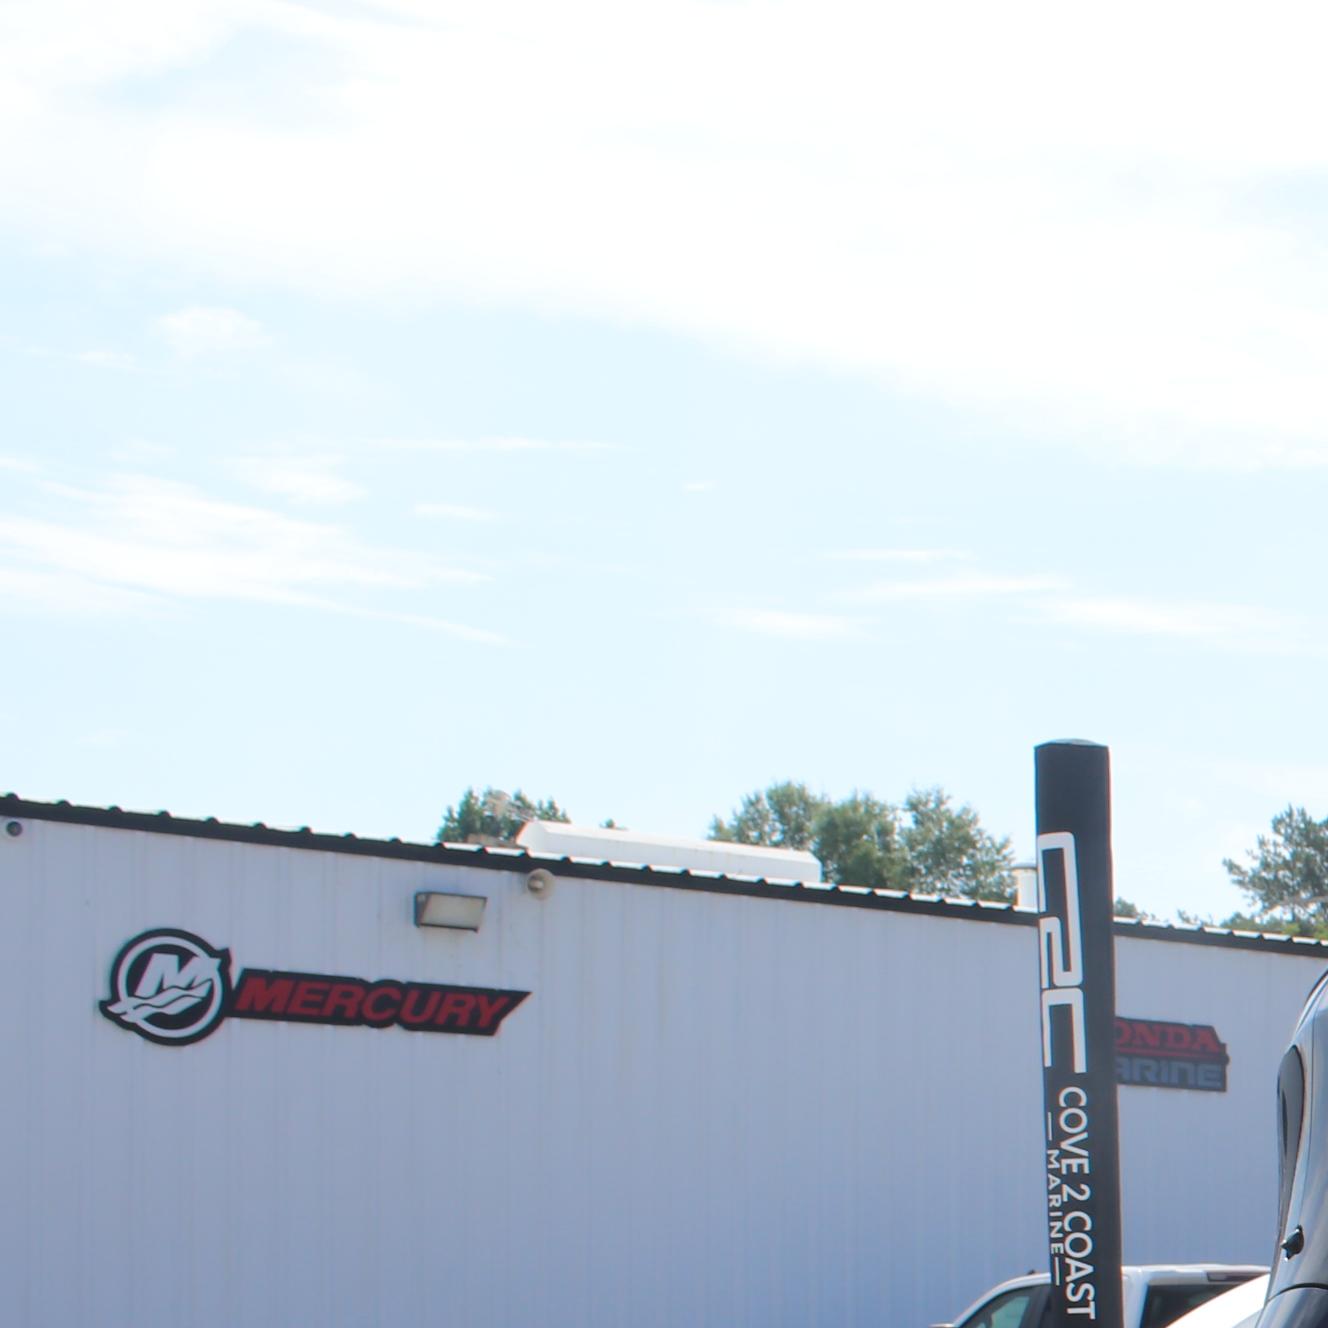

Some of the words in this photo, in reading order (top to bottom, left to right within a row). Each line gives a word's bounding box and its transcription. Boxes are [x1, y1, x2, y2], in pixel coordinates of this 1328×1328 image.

[1036, 831, 1087, 1073] C2C
[234, 976, 509, 1028] MERCURY
[1114, 1020, 1222, 1052] ONDA
[1114, 1056, 1223, 1089] ARINE
[1058, 1086, 1090, 1175] COVE
[1046, 1149, 1064, 1255] MARINE
[1061, 1184, 1091, 1202] 2
[1063, 1210, 1096, 1320] COAST
